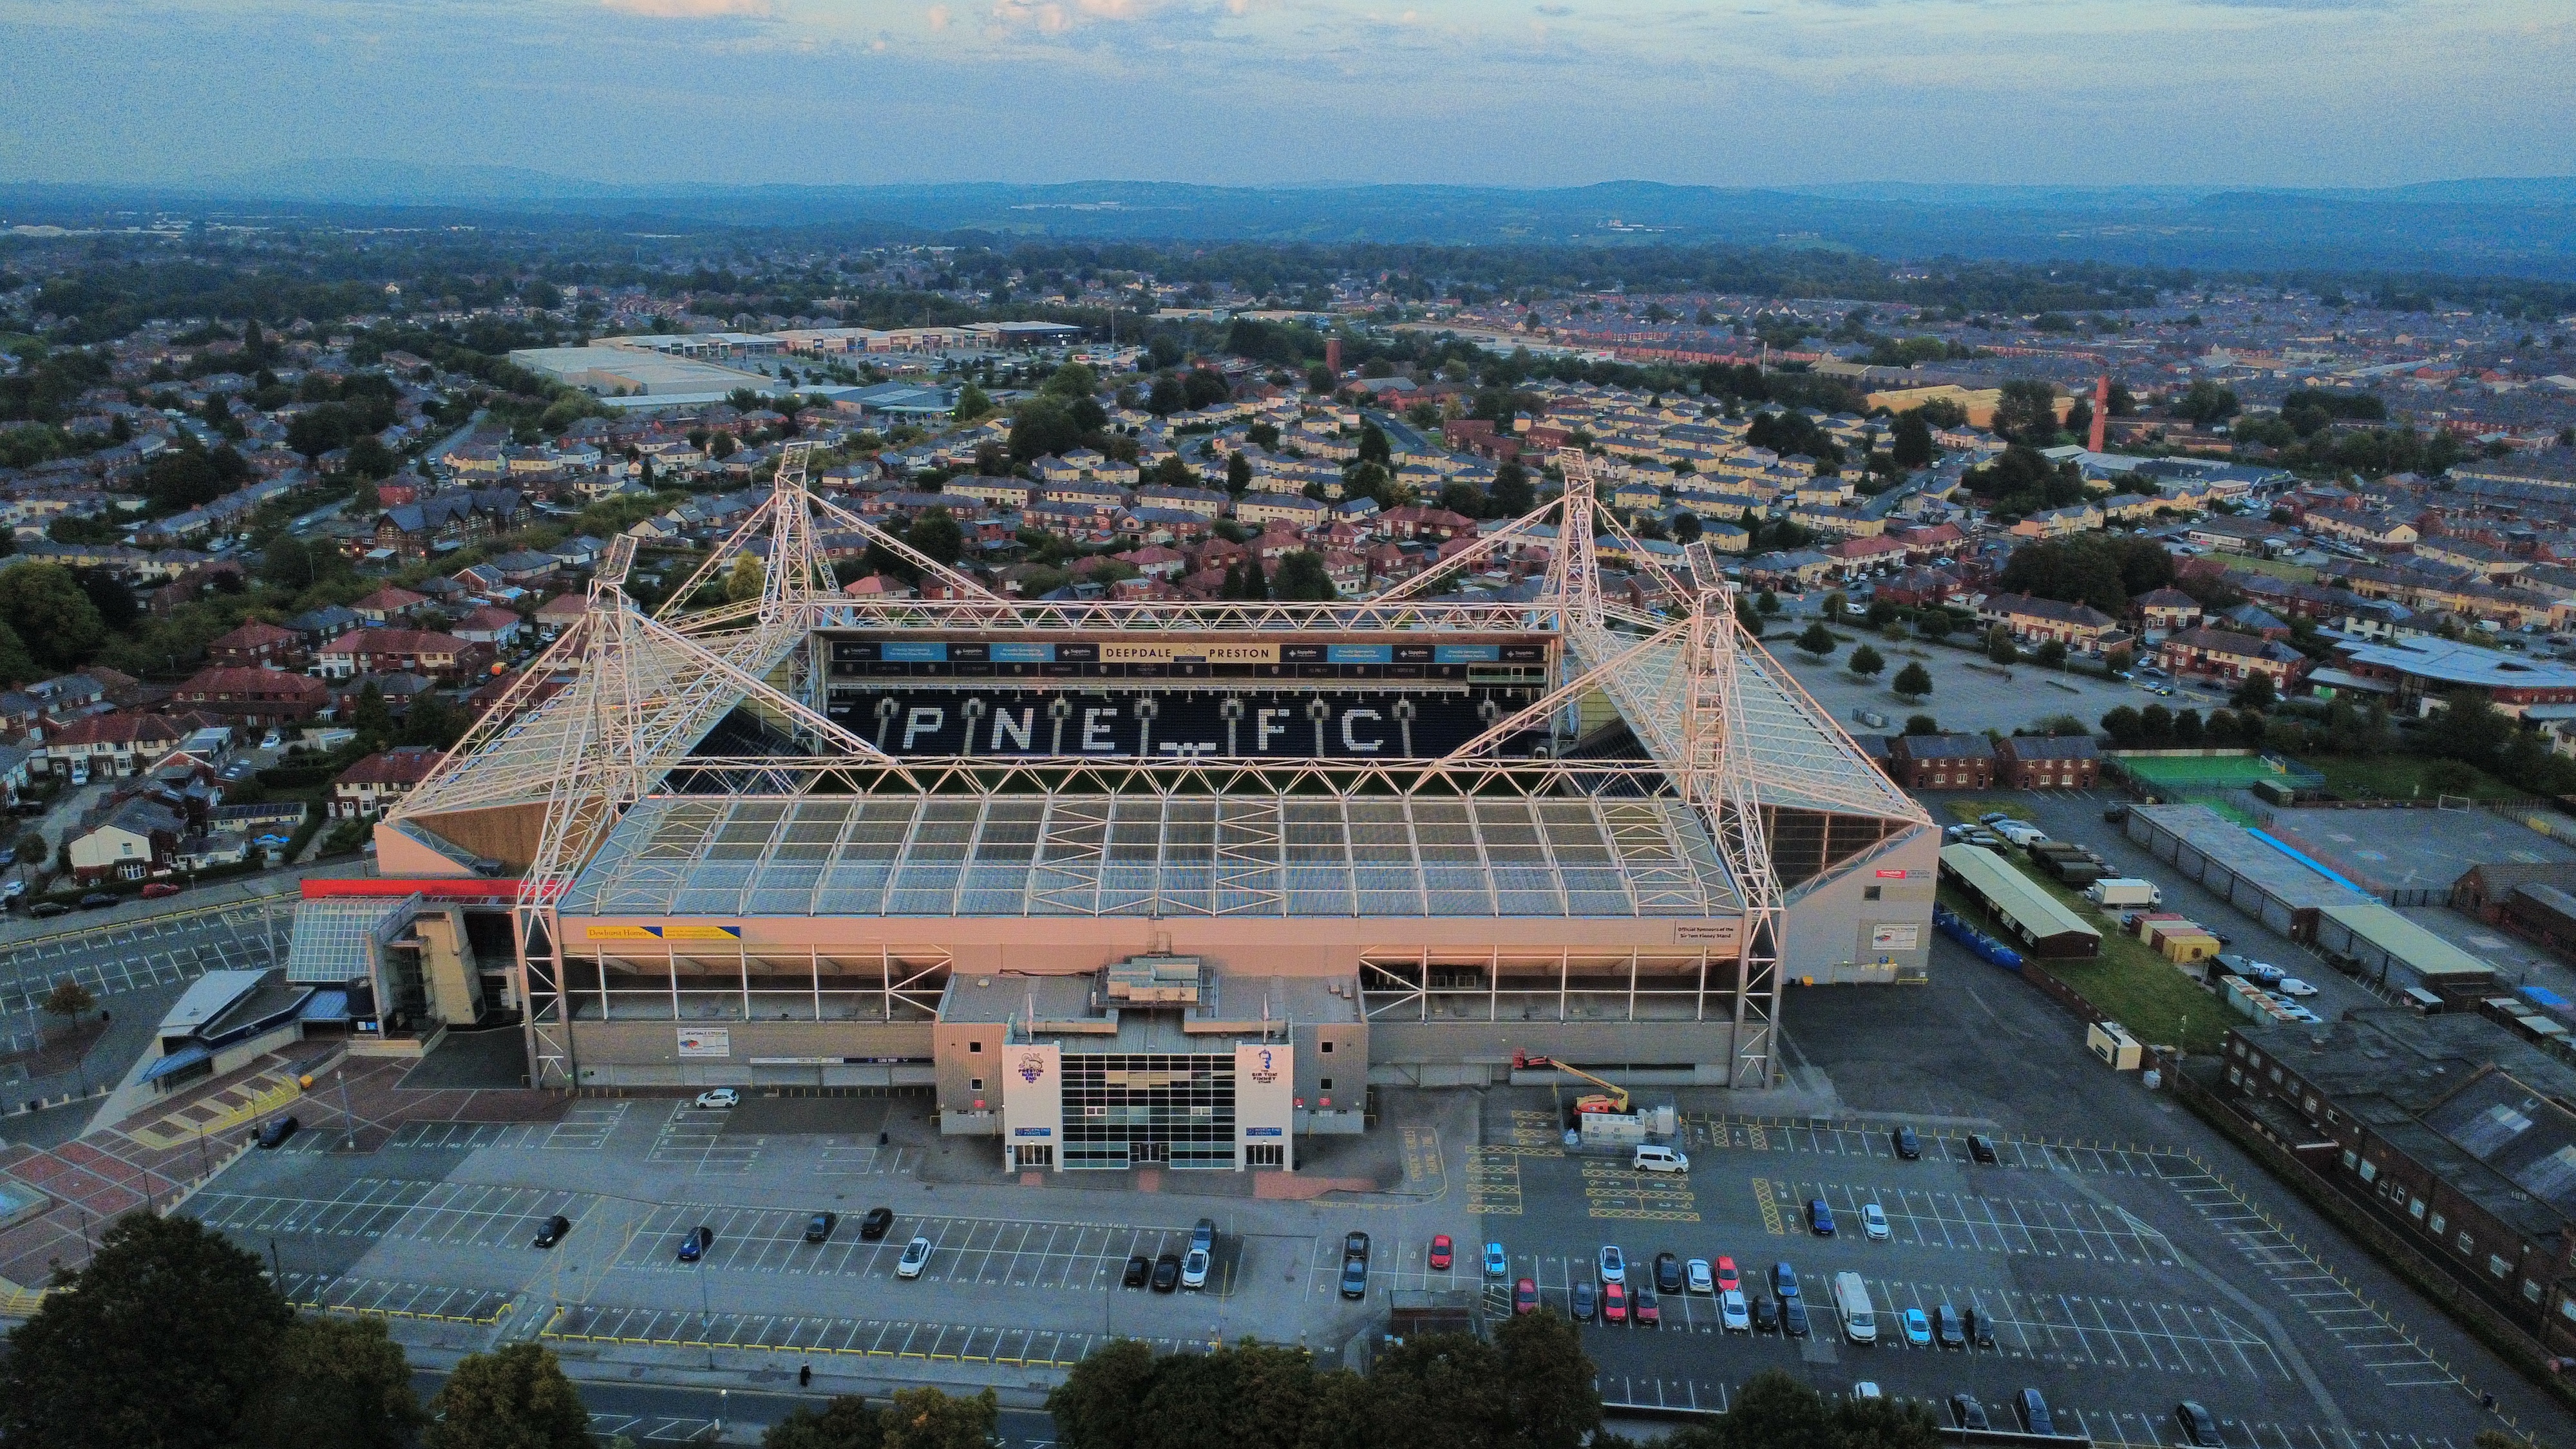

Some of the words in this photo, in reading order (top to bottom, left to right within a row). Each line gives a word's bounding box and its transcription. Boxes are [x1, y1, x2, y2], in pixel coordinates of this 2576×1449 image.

[1106, 649, 1171, 657] DEEPDALE
[1209, 649, 1269, 658] PRESTON
[903, 708, 943, 749] P
[991, 708, 1033, 749] N
[1083, 708, 1117, 750] E
[1258, 709, 1289, 750] F
[1341, 709, 1383, 751] C
